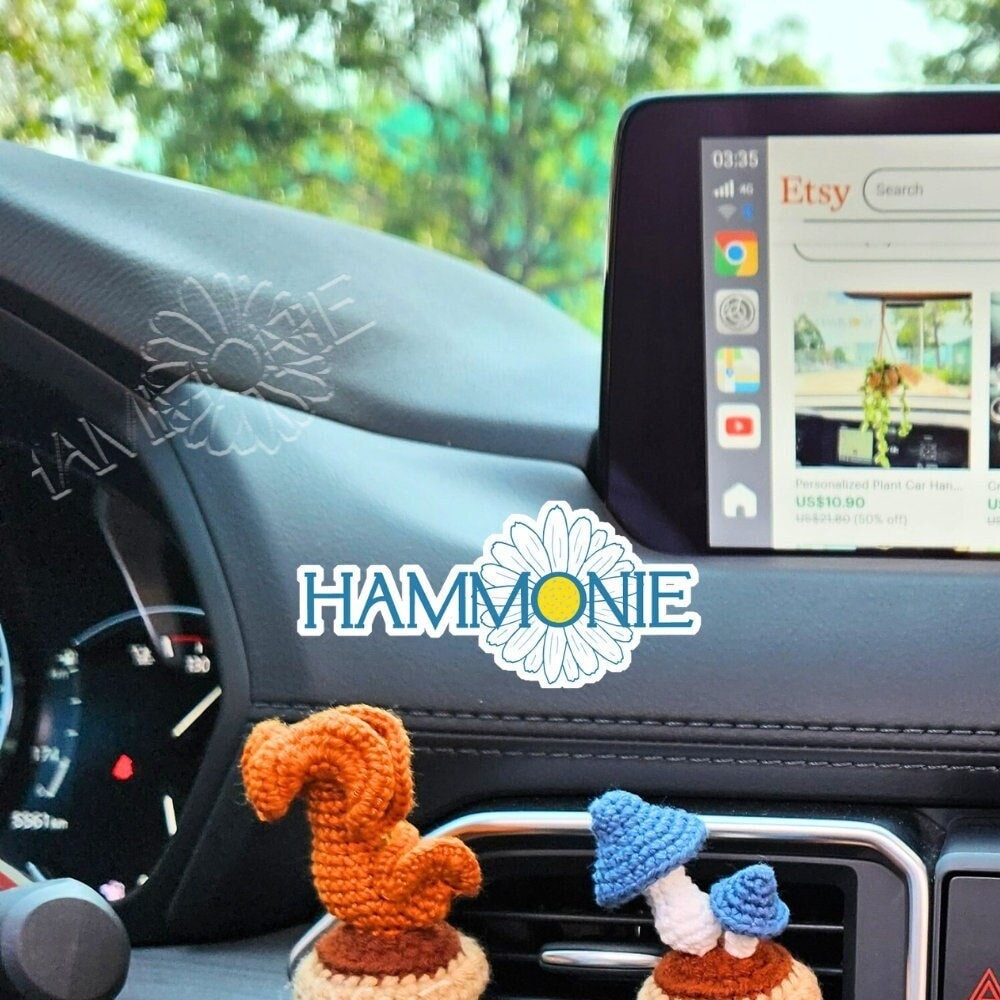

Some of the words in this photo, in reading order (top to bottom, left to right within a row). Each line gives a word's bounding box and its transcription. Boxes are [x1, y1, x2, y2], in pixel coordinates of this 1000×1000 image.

[781, 175, 852, 212] Etsy
[876, 183, 924, 198] Search
[795, 479, 870, 491] Personalized
[873, 479, 903, 491] Plant
[905, 480, 927, 491] Car
[795, 496, 866, 509] US$10.90
[887, 514, 909, 526] off)
